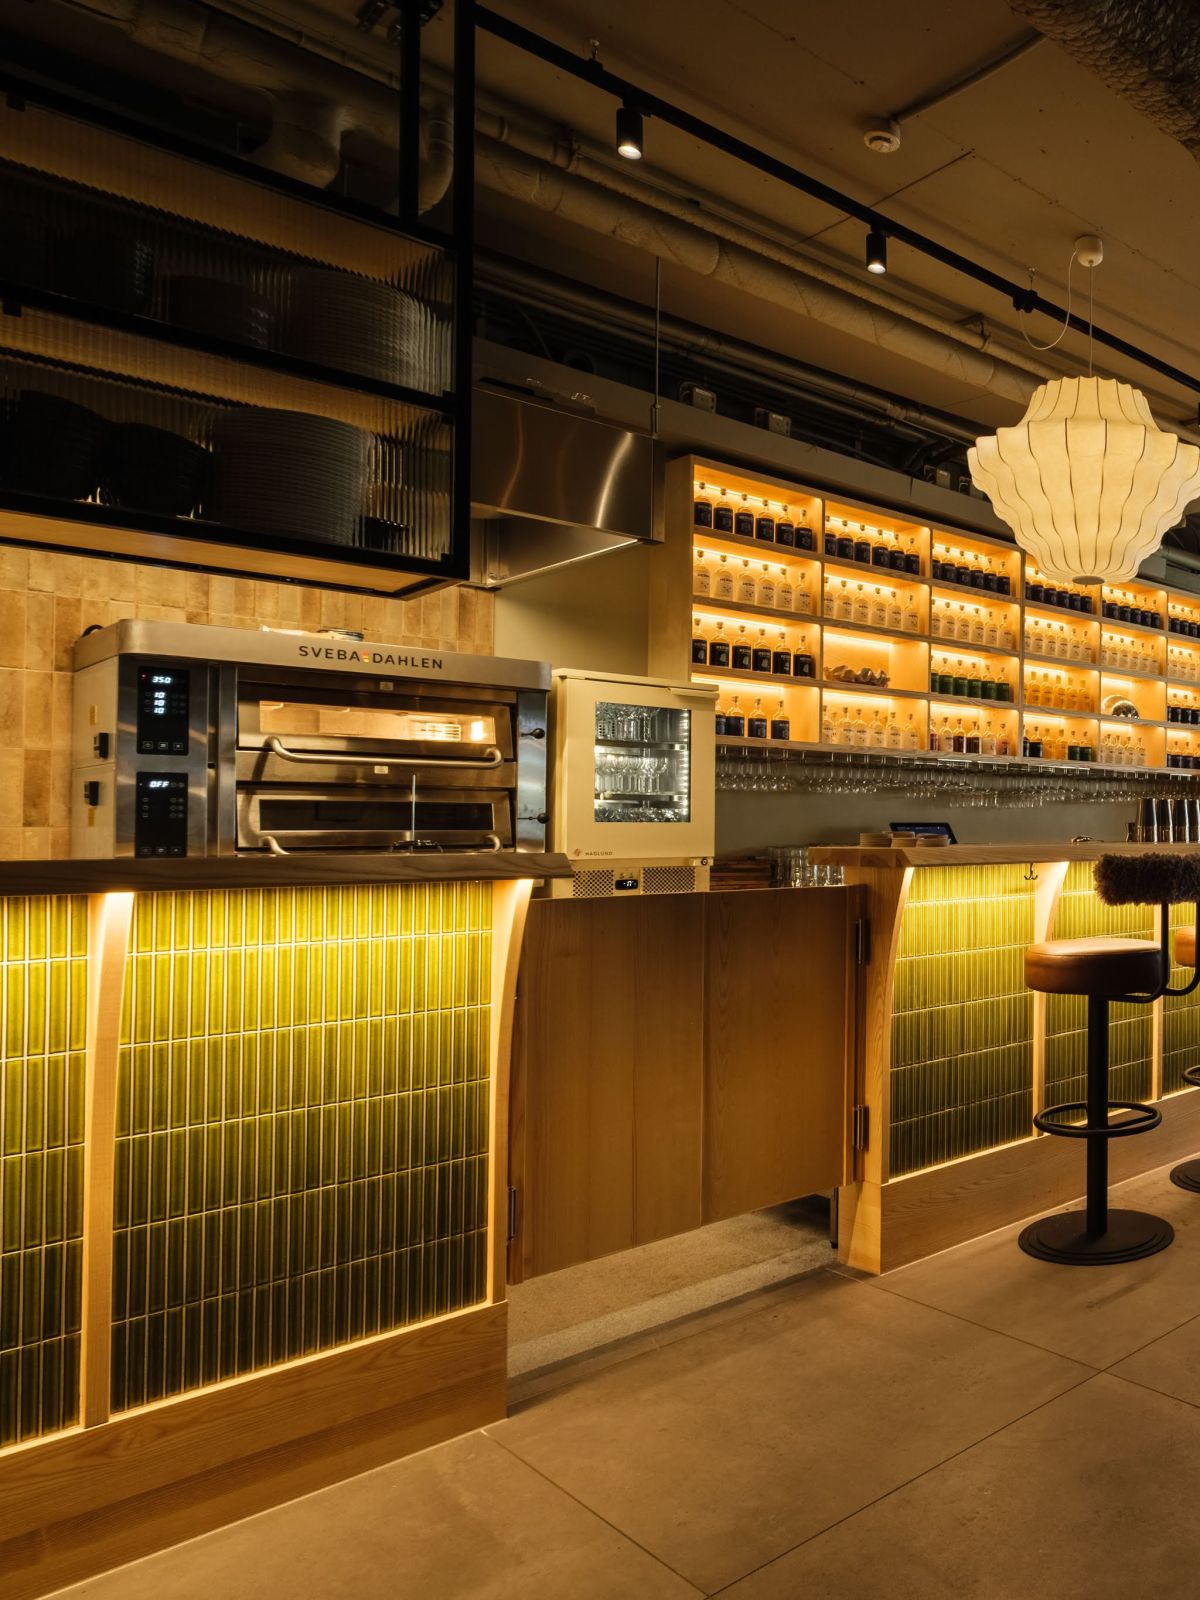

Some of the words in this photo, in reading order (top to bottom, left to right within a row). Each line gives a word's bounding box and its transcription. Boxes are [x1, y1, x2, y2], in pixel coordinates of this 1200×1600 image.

[298, 645, 361, 662] SVEBA
[372, 653, 443, 669] DAHLEN
[152, 675, 172, 684] 350
[149, 780, 170, 788] OFF
